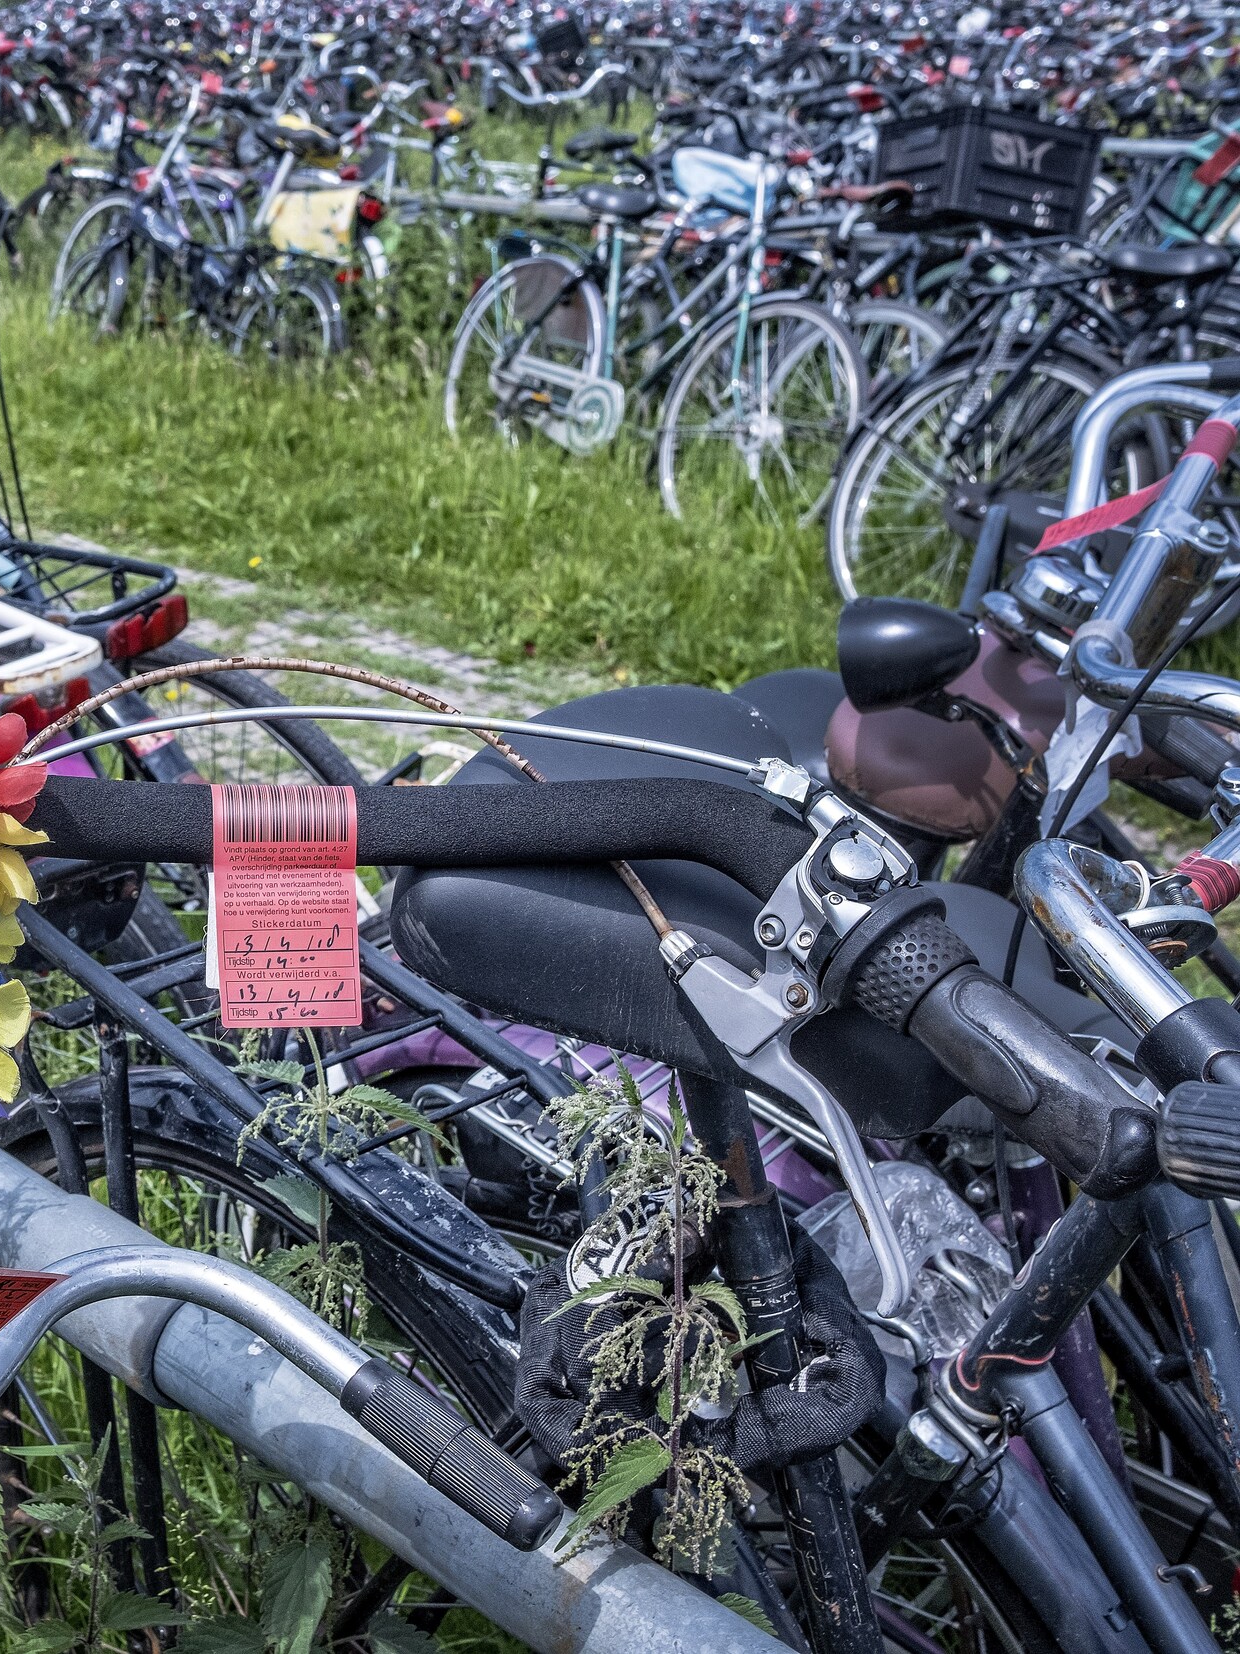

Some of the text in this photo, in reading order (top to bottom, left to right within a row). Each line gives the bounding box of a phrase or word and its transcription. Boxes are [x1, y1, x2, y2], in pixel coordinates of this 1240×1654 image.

[244, 846, 266, 854] plaats
[280, 846, 300, 854] grond
[247, 855, 276, 863] (Hinder,
[324, 854, 342, 862] fiets,
[284, 863, 328, 871] parkeerduur
[227, 882, 263, 891] uitvoering
[279, 880, 344, 888] werkzaamheden).
[277, 889, 321, 897] verwijdering
[277, 899, 289, 907] Op
[245, 908, 290, 916] verwijdering
[252, 920, 322, 928] Stickerdatum
[227, 956, 256, 967] Tijdstip
[237, 969, 341, 979] Wordt verwijderd v.a.
[230, 1007, 259, 1018] Tijdstip
